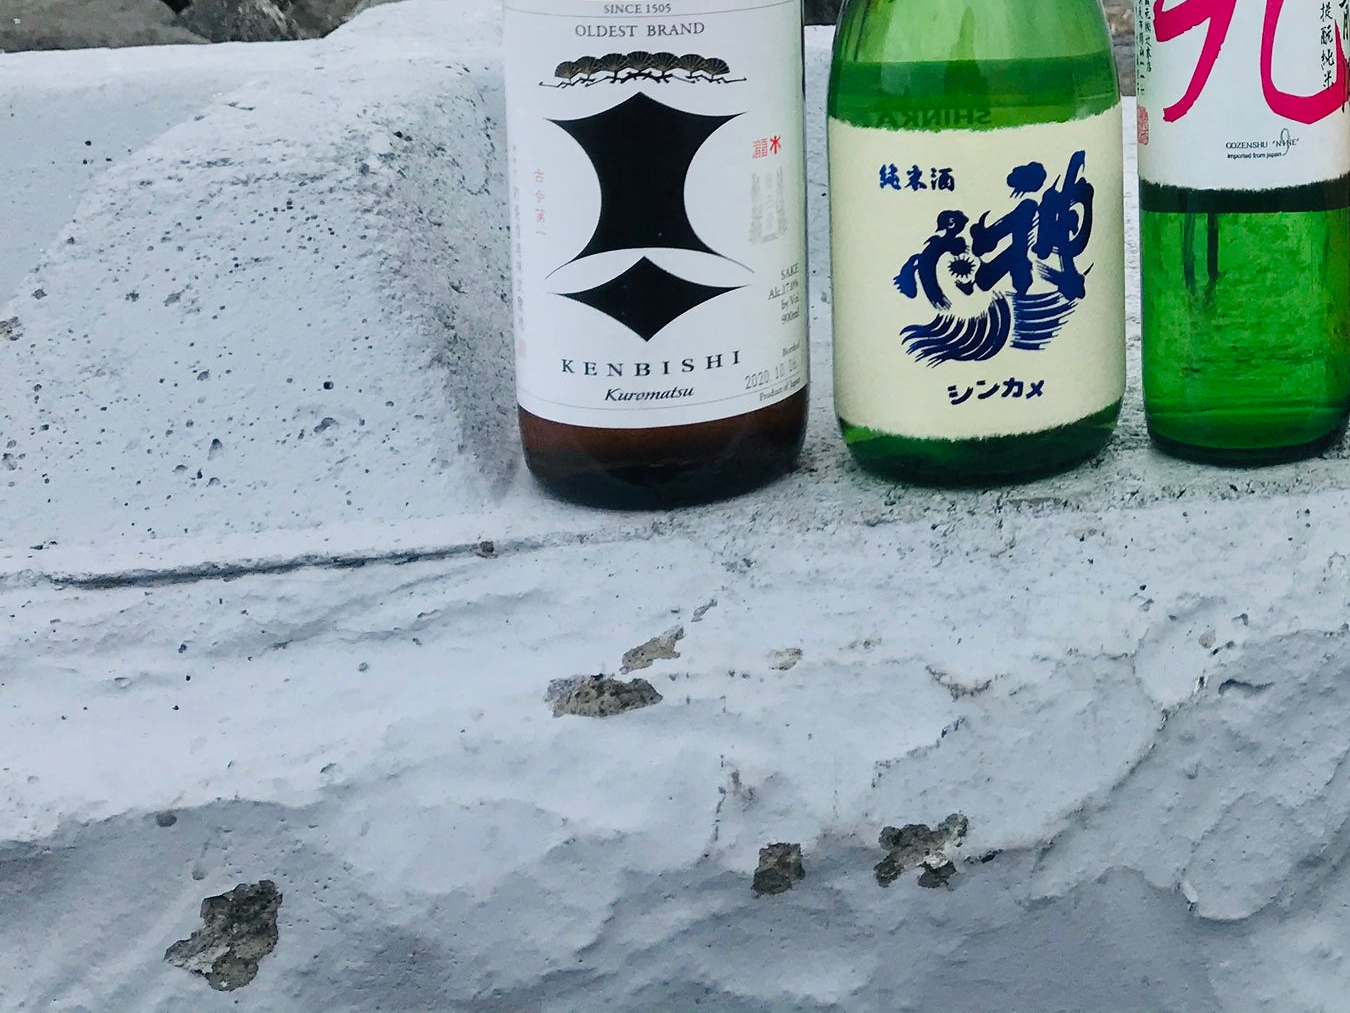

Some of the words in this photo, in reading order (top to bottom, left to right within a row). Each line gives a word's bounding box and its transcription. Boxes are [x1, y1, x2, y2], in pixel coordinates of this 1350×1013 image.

[603, 3, 642, 15] SINCE
[646, 2, 672, 14] 1505
[574, 25, 638, 38] OLDEST
[647, 22, 706, 37] BRAND
[1225, 141, 1268, 149] GOZENSHU
[878, 163, 956, 192] 純米酒
[561, 349, 741, 378] KENBISHI
[603, 385, 695, 402] Kuromatsu
[947, 378, 1046, 406] シンカメ
